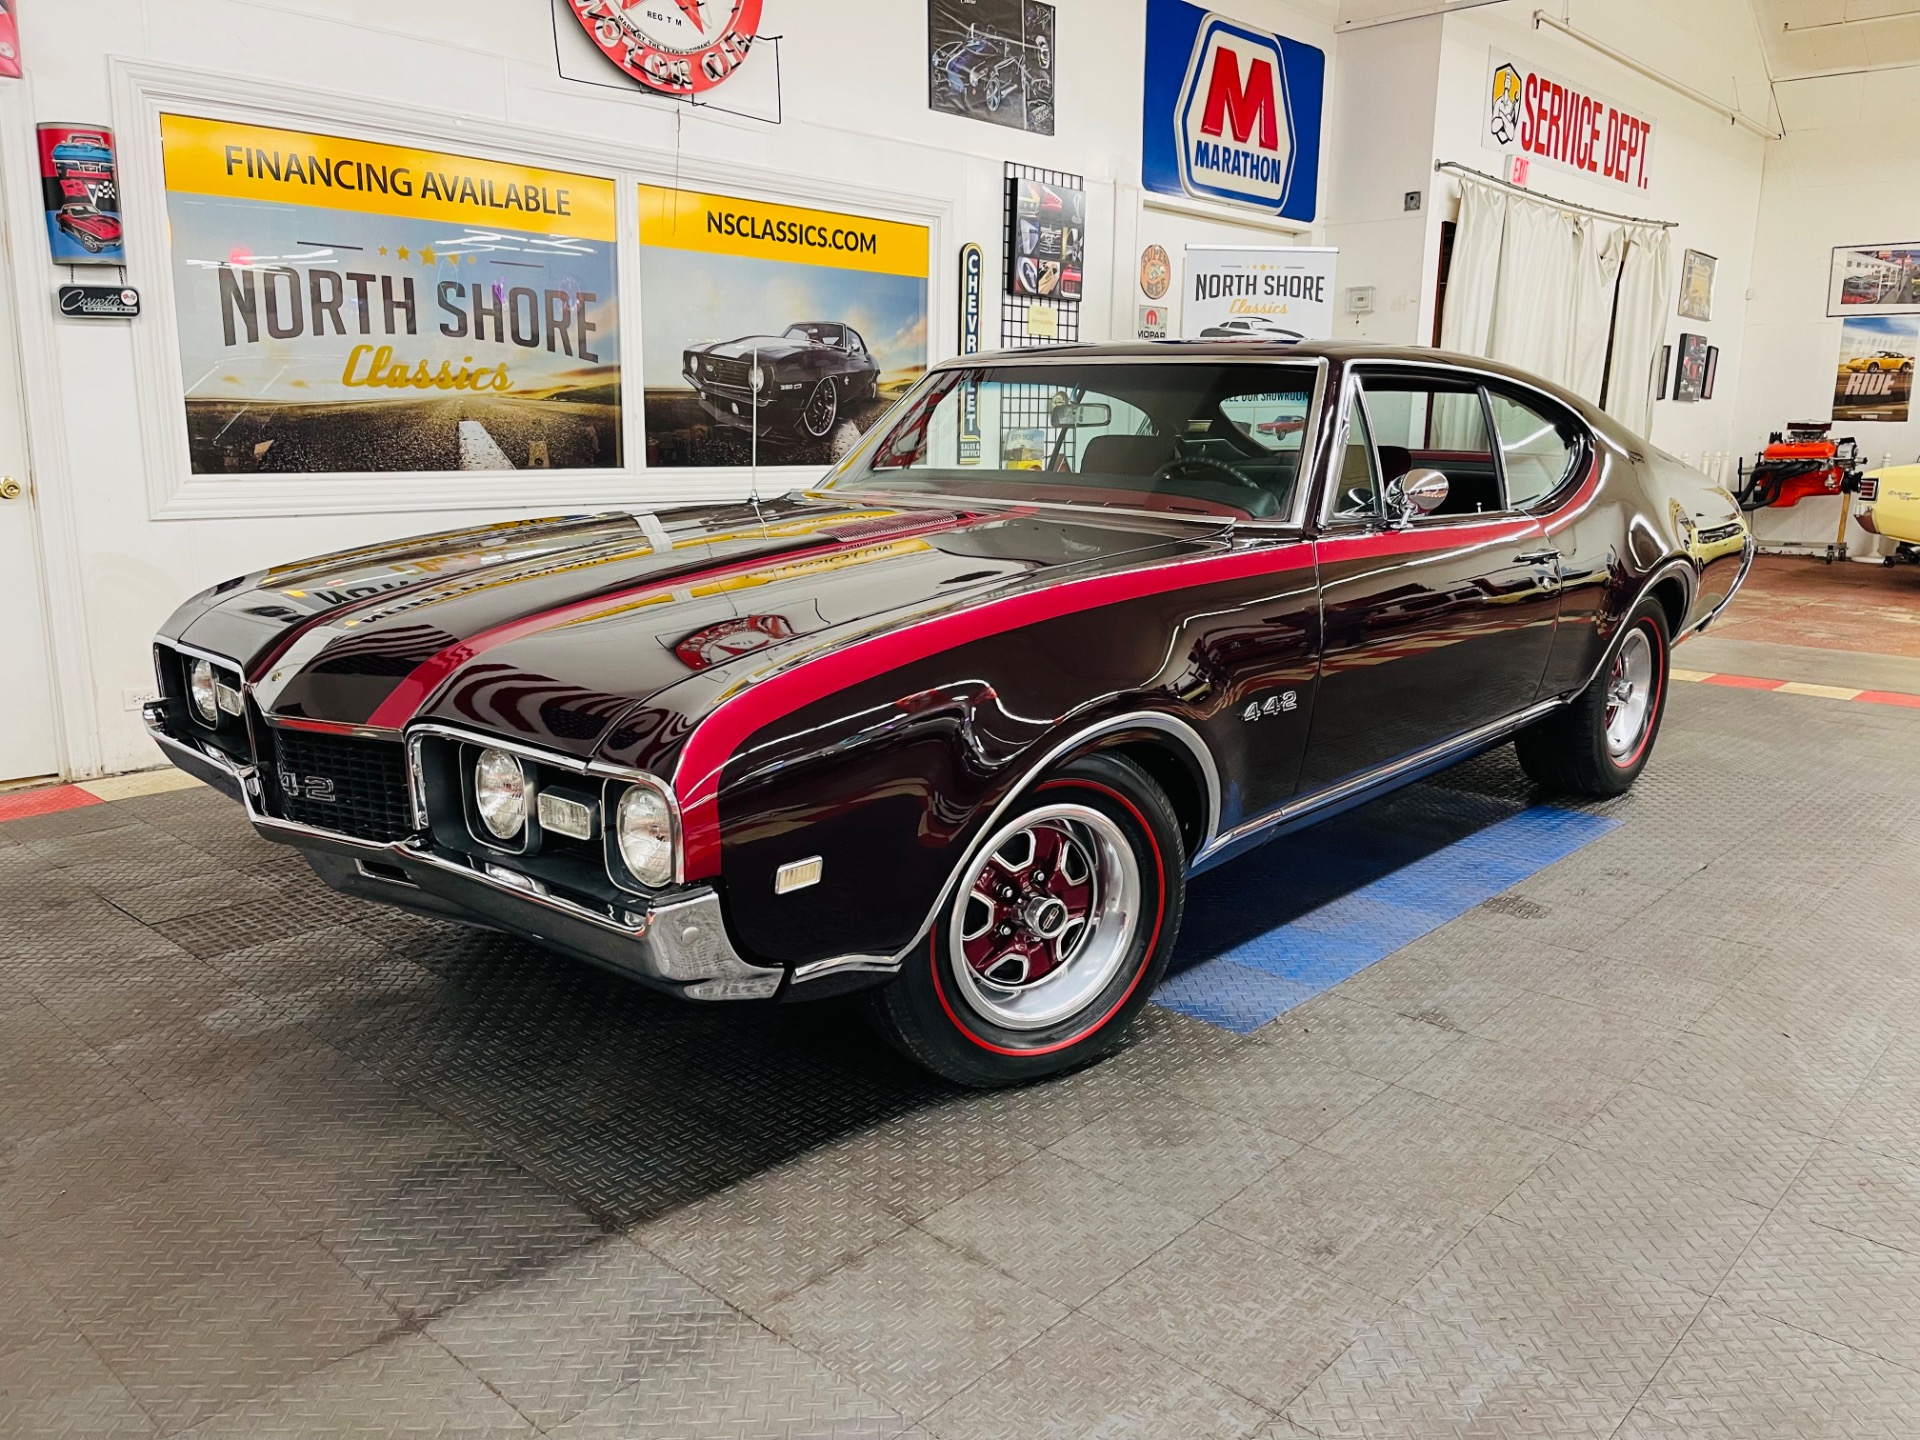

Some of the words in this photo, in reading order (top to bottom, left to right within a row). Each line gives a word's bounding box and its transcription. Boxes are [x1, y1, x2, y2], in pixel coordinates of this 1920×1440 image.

[647, 10, 663, 21] REG
[666, 16, 672, 24] T
[675, 19, 682, 27] M
[574, 0, 693, 90] MOTOR
[701, 31, 754, 82] OIL
[648, 40, 660, 50] THE
[1200, 45, 1279, 152] M
[1520, 72, 1603, 173] SERVICE
[1603, 107, 1651, 190] DEPT.
[1194, 140, 1281, 185] MARATHON
[1512, 156, 1530, 186] EXIT
[225, 145, 412, 197] FINANCING
[421, 172, 571, 216] AVAILABLE
[707, 210, 877, 254] NSCLASSICS.COM
[1142, 247, 1168, 269] SUPER
[61, 289, 123, 311] Corvette
[1147, 278, 1166, 297] BEE
[1195, 273, 1257, 302] NORTH
[1264, 275, 1325, 303] SHORE
[218, 264, 417, 346] NORTH
[438, 281, 599, 364] SHORE
[1229, 298, 1288, 315] Classics
[966, 254, 980, 432] CHEVRLET
[1138, 331, 1166, 339] MOPAR
[342, 344, 514, 391] Classics
[1845, 373, 1895, 396] RIDE
[1244, 690, 1298, 721] 442
